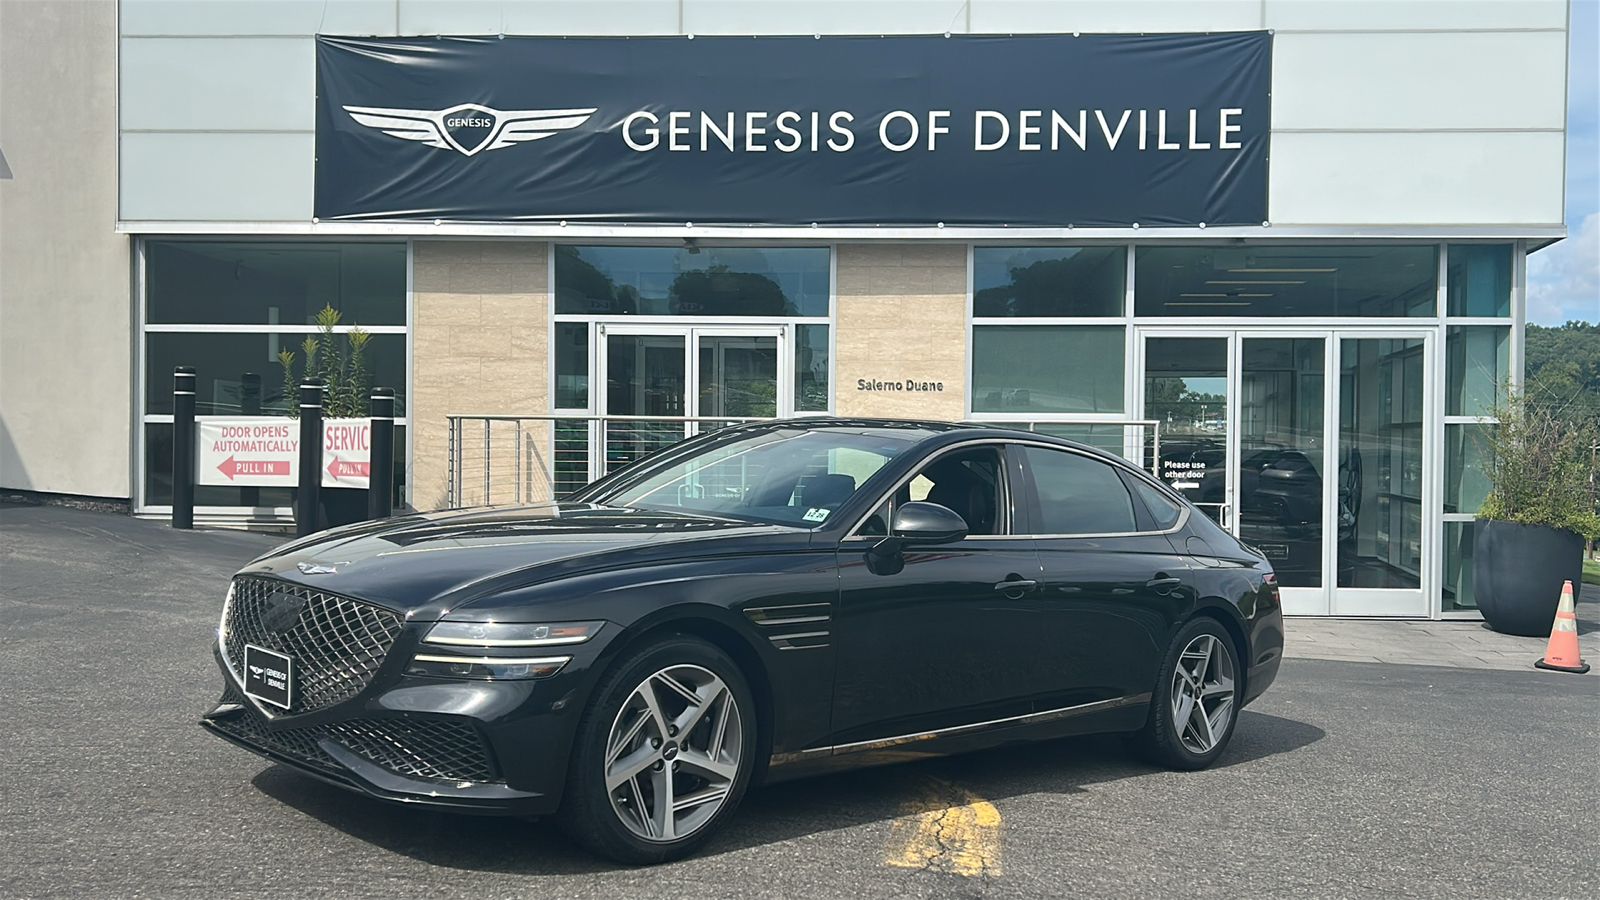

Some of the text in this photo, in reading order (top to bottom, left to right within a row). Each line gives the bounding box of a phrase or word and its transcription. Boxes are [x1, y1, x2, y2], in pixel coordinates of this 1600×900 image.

[447, 118, 491, 128] GENESIS
[622, 108, 1243, 153] GENESIS OF DENVILLE
[857, 379, 944, 392] Salerno Duane
[221, 426, 289, 438] DOOR OPENS
[325, 425, 371, 451] SERVIC
[213, 440, 298, 452] AUTOMATICALLY
[236, 463, 274, 473] PULL IN
[338, 464, 353, 474] PULL
[1164, 461, 1190, 469] Please
[1164, 470, 1205, 479] other door
